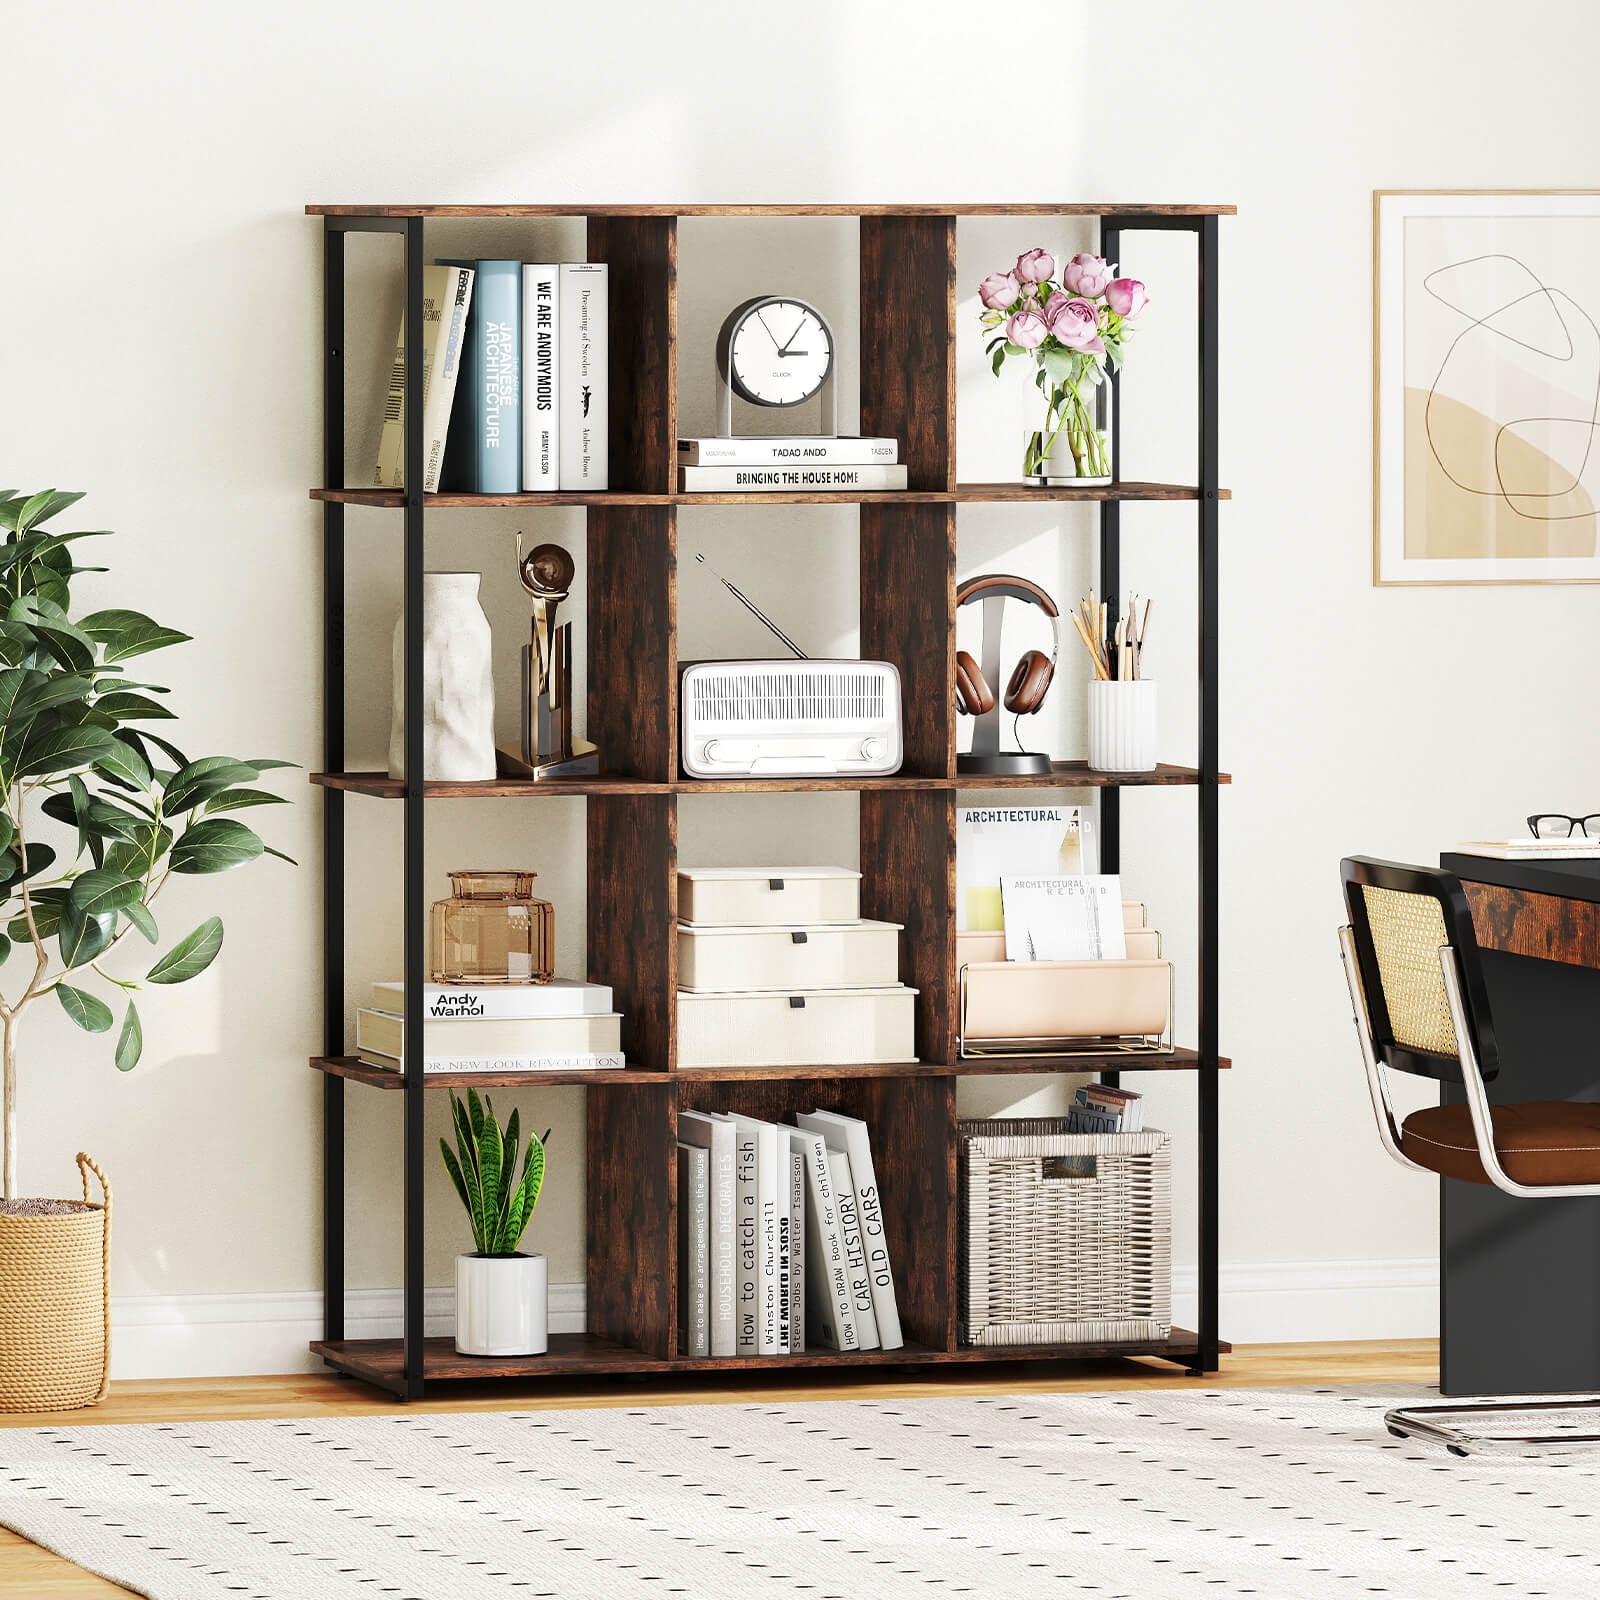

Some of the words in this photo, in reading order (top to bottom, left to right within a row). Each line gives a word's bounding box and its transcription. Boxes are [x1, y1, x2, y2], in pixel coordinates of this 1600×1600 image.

[537, 282, 551, 300] WE
[537, 304, 551, 328] ARE
[580, 290, 591, 331] Dreaming
[582, 334, 591, 342] of
[499, 323, 512, 406] JAPANESE
[537, 333, 551, 410] ANONYMOUS
[582, 343, 590, 377] Sweden
[486, 322, 499, 448] ARCHITECTURE
[541, 431, 549, 451] PARMY
[541, 454, 549, 475] OLSON
[736, 473, 779, 484] BRINGING
[782, 472, 799, 483] THE
[802, 472, 831, 483] HOUSE
[833, 472, 859, 482] HOME
[966, 810, 1061, 823] ARCHITECTURAL
[1015, 880, 1084, 888] ARCHITECTURAL
[431, 1005, 484, 1016] Warhol
[437, 994, 477, 1006] Andy
[449, 1061, 482, 1070] NEW
[485, 1059, 522, 1069] LOOK
[696, 1153, 704, 1179] house
[738, 1142, 754, 1183] fish
[813, 1142, 830, 1198] children
[695, 1184, 704, 1198] the
[719, 1154, 732, 1232] DECORATES
[793, 1156, 801, 1209] Isaacson
[695, 1203, 704, 1212] in
[743, 1196, 754, 1205] a
[860, 1186, 882, 1236] CARS
[823, 1206, 835, 1226] for
[764, 1200, 774, 1276] Churchill
[793, 1217, 801, 1256] Walter
[838, 1192, 863, 1268] HISTORY
[696, 1218, 706, 1273] arrangement
[739, 1217, 754, 1270] catch
[828, 1233, 841, 1261] Book
[719, 1241, 732, 1320] HOUSEHOLD
[793, 1263, 802, 1276] by
[871, 1249, 890, 1287] OLD
[697, 1278, 704, 1289] an
[740, 1282, 754, 1302] to
[834, 1267, 846, 1295] DRAW
[695, 1293, 704, 1314] make
[853, 1279, 871, 1312] CAR
[765, 1285, 774, 1344] Winston
[840, 1303, 849, 1317] TO
[696, 1318, 704, 1328] to
[740, 1314, 754, 1345] How
[843, 1323, 855, 1344] HOW
[695, 1330, 704, 1349] How
